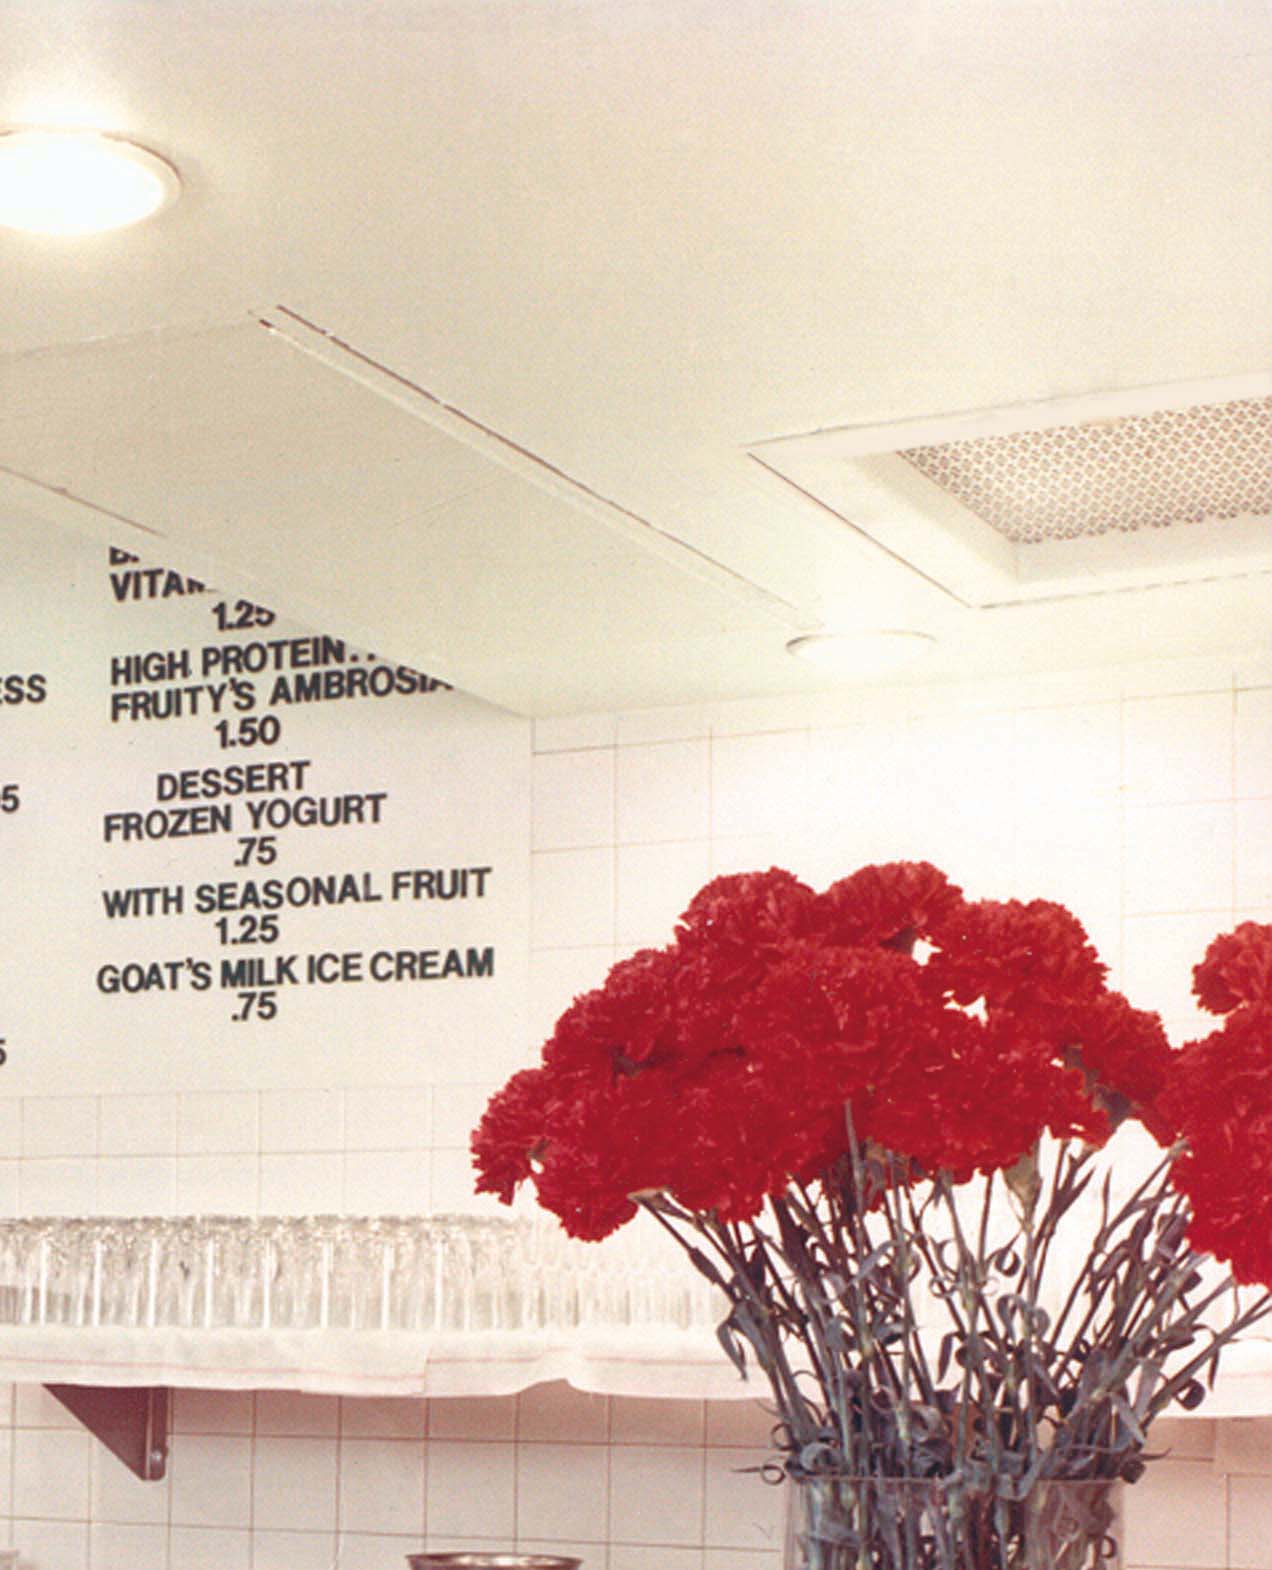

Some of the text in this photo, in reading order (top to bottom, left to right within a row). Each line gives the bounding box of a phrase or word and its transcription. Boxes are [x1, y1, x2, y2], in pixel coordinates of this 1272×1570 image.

[109, 568, 205, 602] VITA
[111, 649, 192, 686] HIGH
[111, 677, 256, 723] FRUITY'S
[215, 715, 281, 749] 1.50
[157, 760, 311, 802] DESSERT
[104, 793, 387, 842] FROZEN YOGURT
[234, 836, 277, 867] .75
[102, 867, 492, 919] WITH SEASONAL FRUIT
[215, 914, 279, 945] 1.25
[97, 947, 494, 994] GOAT'S MILK ICE CREAM
[231, 991, 277, 1021] .75
